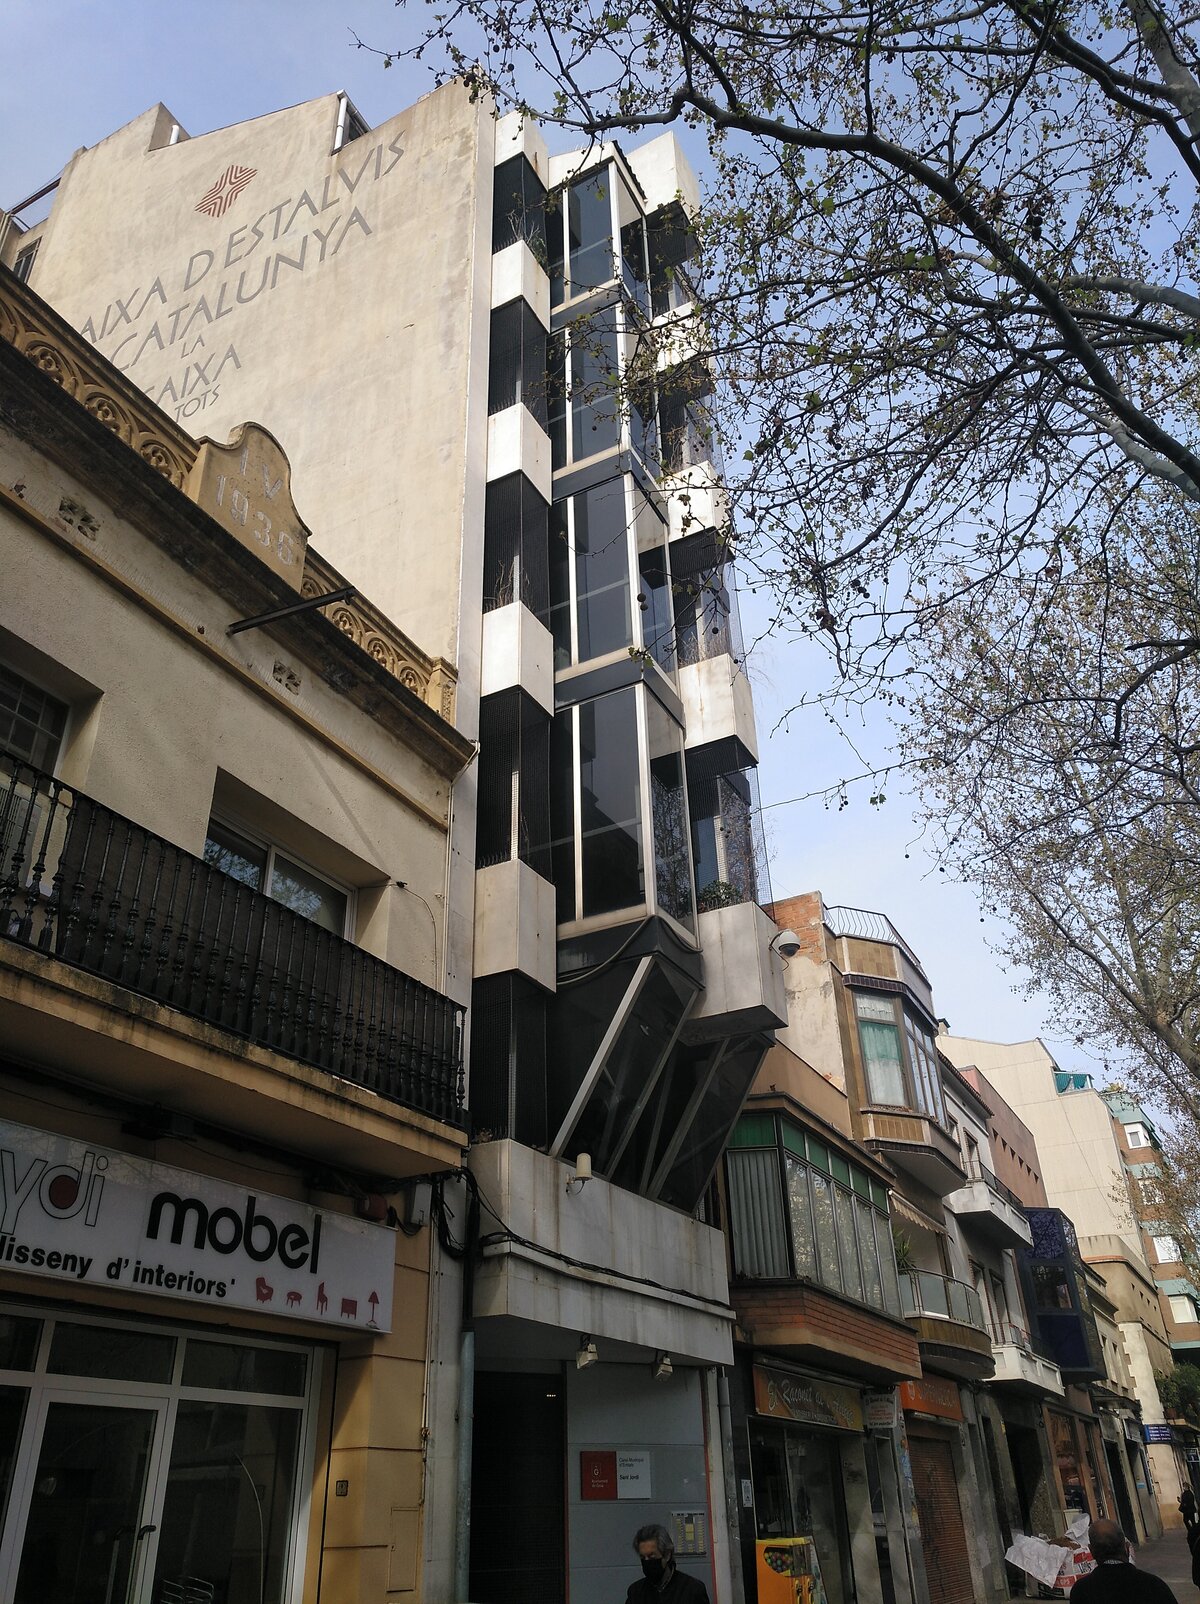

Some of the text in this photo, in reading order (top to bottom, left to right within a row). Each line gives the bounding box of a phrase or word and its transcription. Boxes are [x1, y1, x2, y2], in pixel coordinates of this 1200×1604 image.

[224, 130, 406, 269] ESTALVIS
[110, 205, 372, 372] CATALUNYA
[181, 334, 205, 359] LA
[174, 384, 220, 423] TOTS
[145, 1191, 322, 1275] mobel
